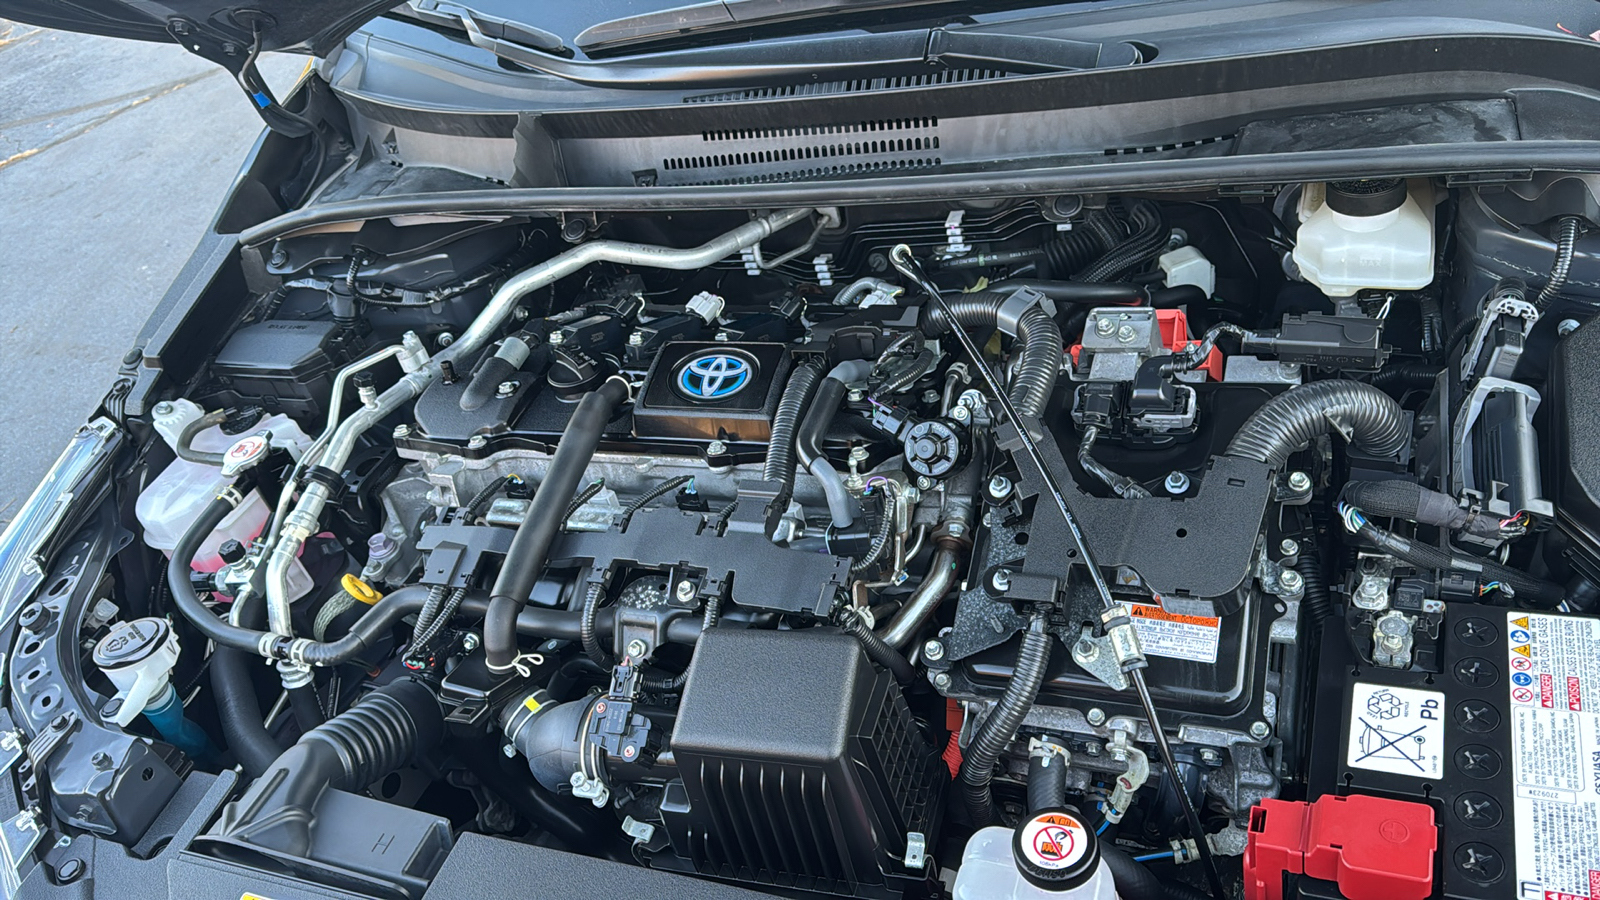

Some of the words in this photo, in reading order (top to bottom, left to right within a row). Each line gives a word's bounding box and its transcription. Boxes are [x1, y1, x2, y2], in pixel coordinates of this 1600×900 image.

[1360, 259, 1381, 267] MAX
[1537, 617, 1549, 638] GASES
[1539, 639, 1551, 673] EXPLOSIVE
[1541, 674, 1553, 701] DANGER
[1568, 677, 1580, 704] POISON
[1420, 699, 1439, 720] Pb
